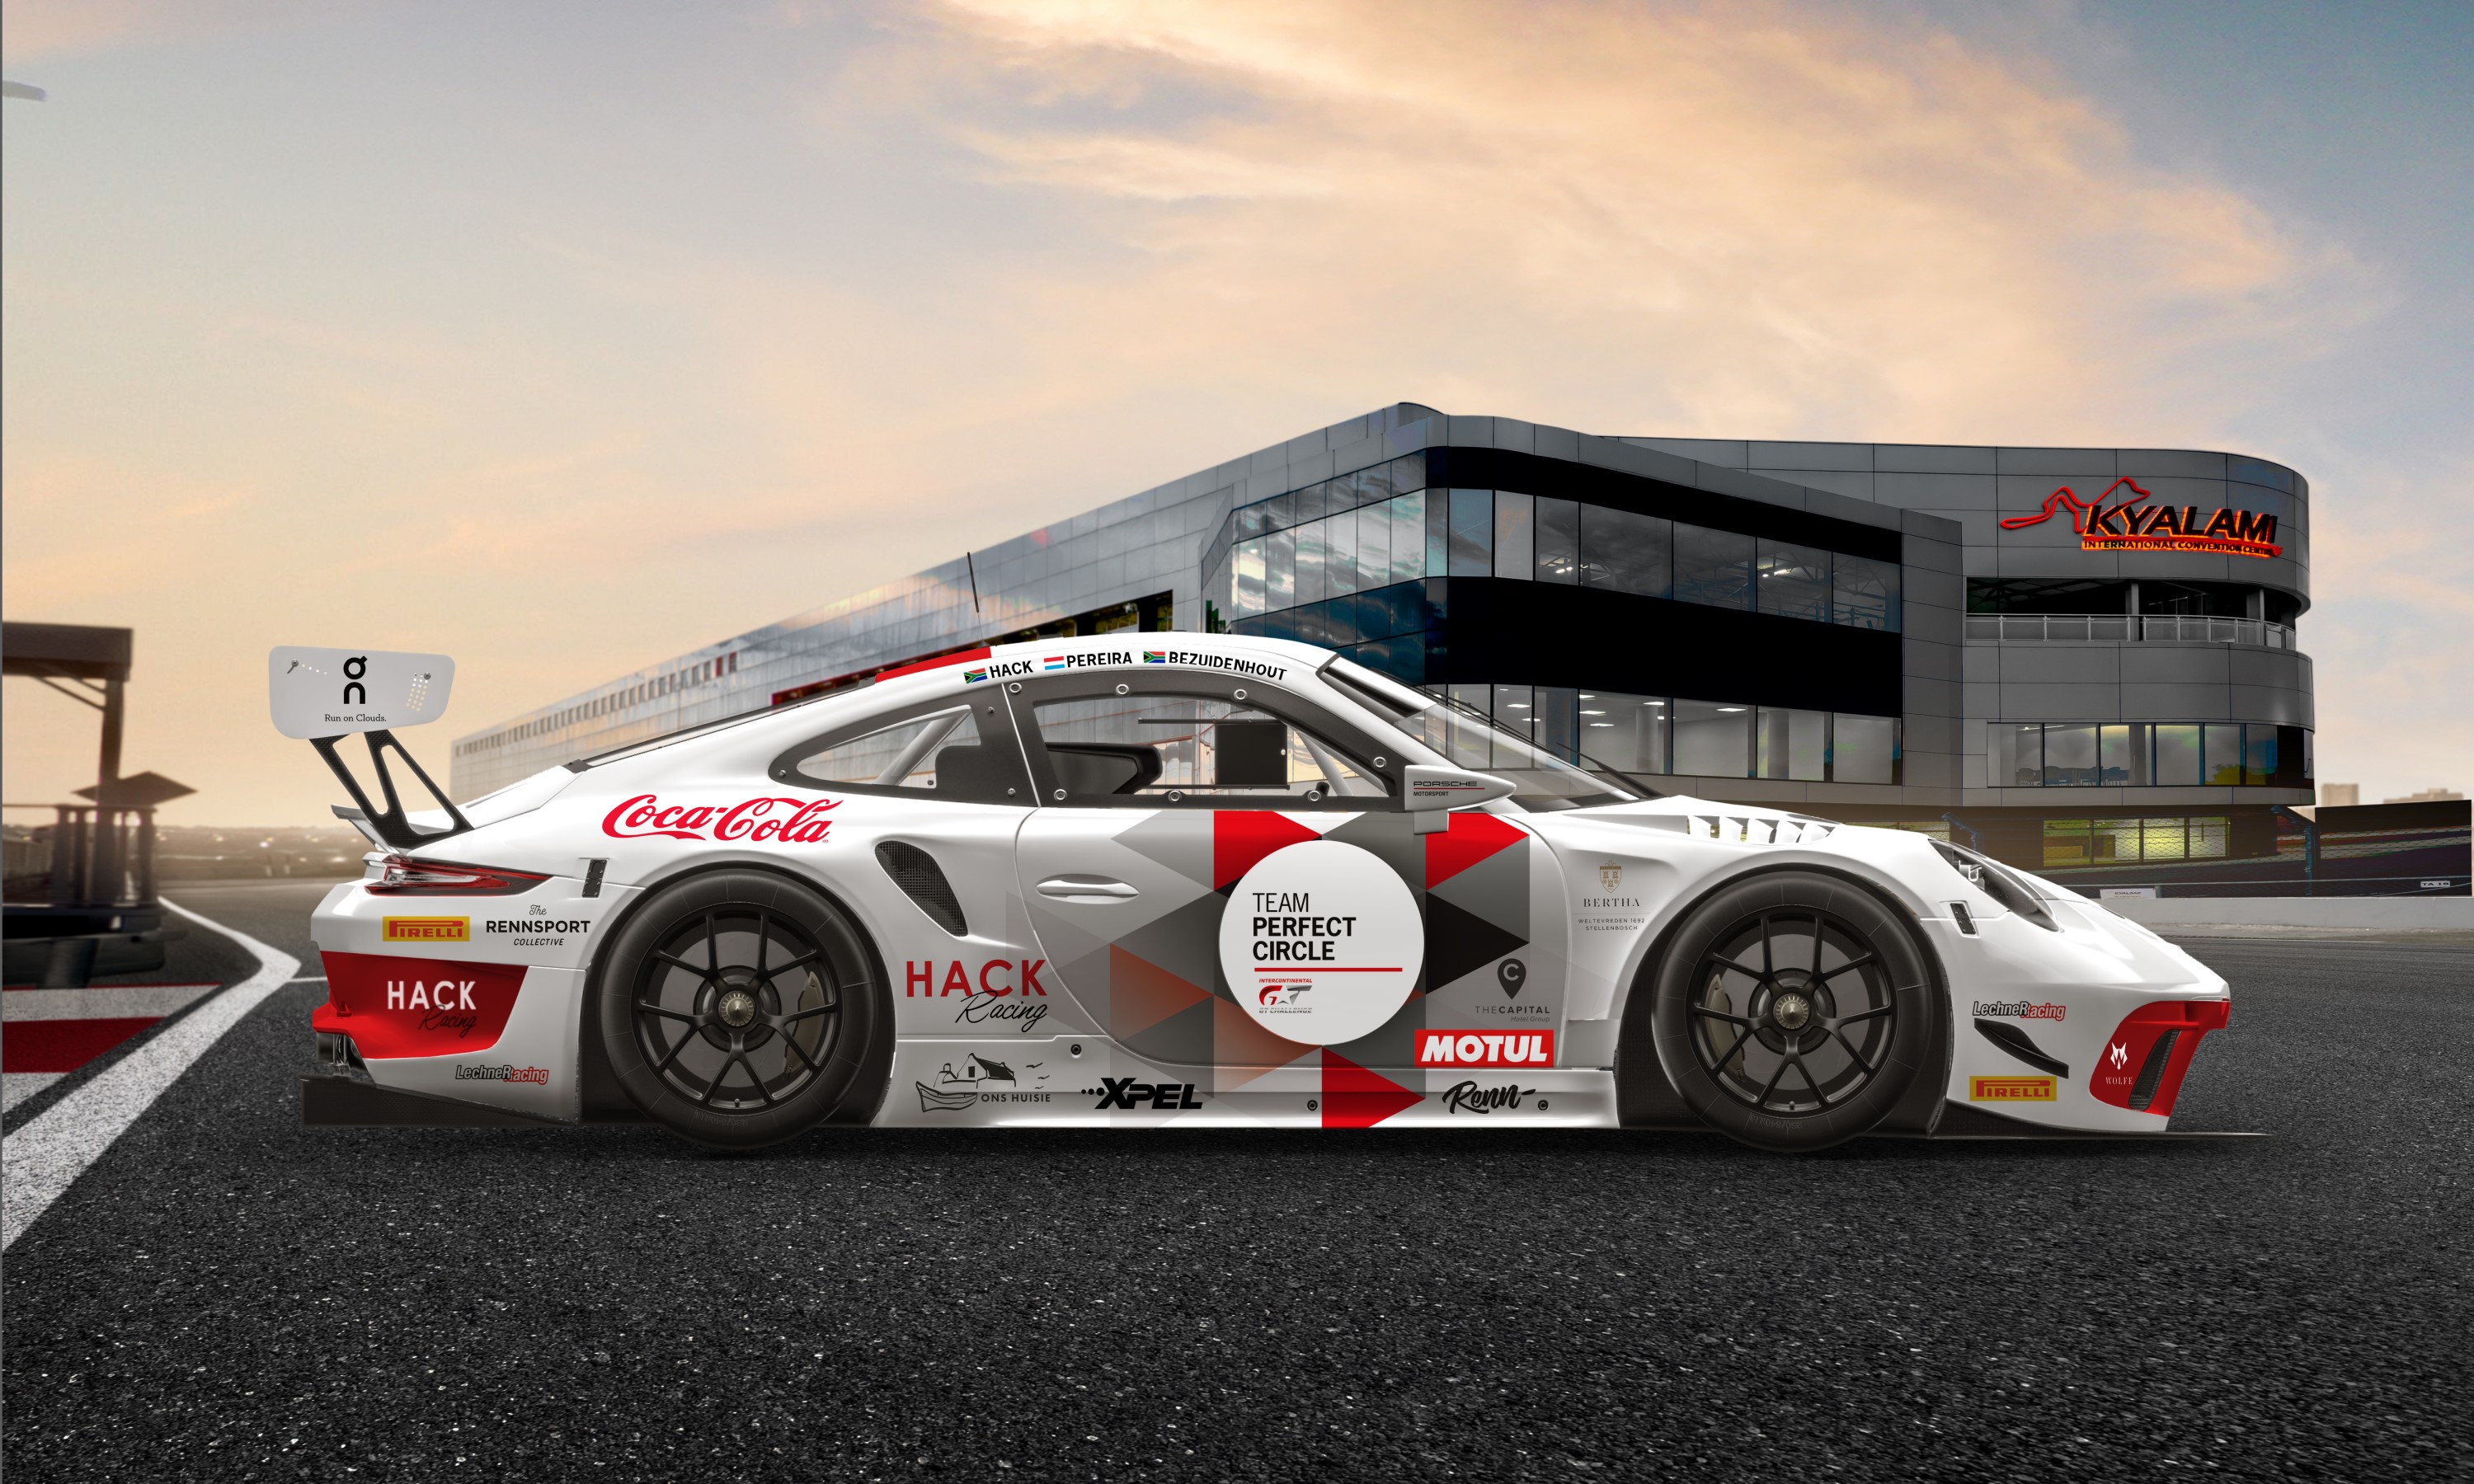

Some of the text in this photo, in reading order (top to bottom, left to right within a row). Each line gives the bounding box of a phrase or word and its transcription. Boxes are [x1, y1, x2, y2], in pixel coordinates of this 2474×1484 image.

[2084, 505, 2278, 544] KYALAMI
[2083, 540, 2175, 550] INTERNATIONAL
[2177, 541, 2242, 553] CONVENTION
[1066, 651, 1132, 668] PEREIRA
[1169, 651, 1287, 680] BEZUIDENHOUT
[990, 660, 1033, 679] HACK
[325, 714, 341, 722] Run
[355, 714, 387, 722] Clouds.
[602, 794, 844, 843] Coca-Cola
[529, 904, 547, 916] The
[1253, 893, 1310, 913] TEAM
[1583, 898, 1640, 907] BERTHA
[388, 920, 464, 937] PIRELLI
[486, 920, 591, 933] RENNSPORT
[1253, 917, 1357, 937] PERFECT
[1253, 941, 1335, 960] CIRCLE
[906, 959, 1047, 998] HACK
[387, 980, 477, 1011] HACK
[955, 990, 1048, 1033] Racing
[417, 1004, 477, 1039] Racing
[1421, 1035, 1548, 1063] MOTUL
[1976, 1080, 2052, 1097] PIRELLI
[2105, 1077, 2133, 1085] WOLFE
[981, 1094, 1051, 1103] ONS HUISIE
[1094, 1078, 1203, 1110] XPEL
